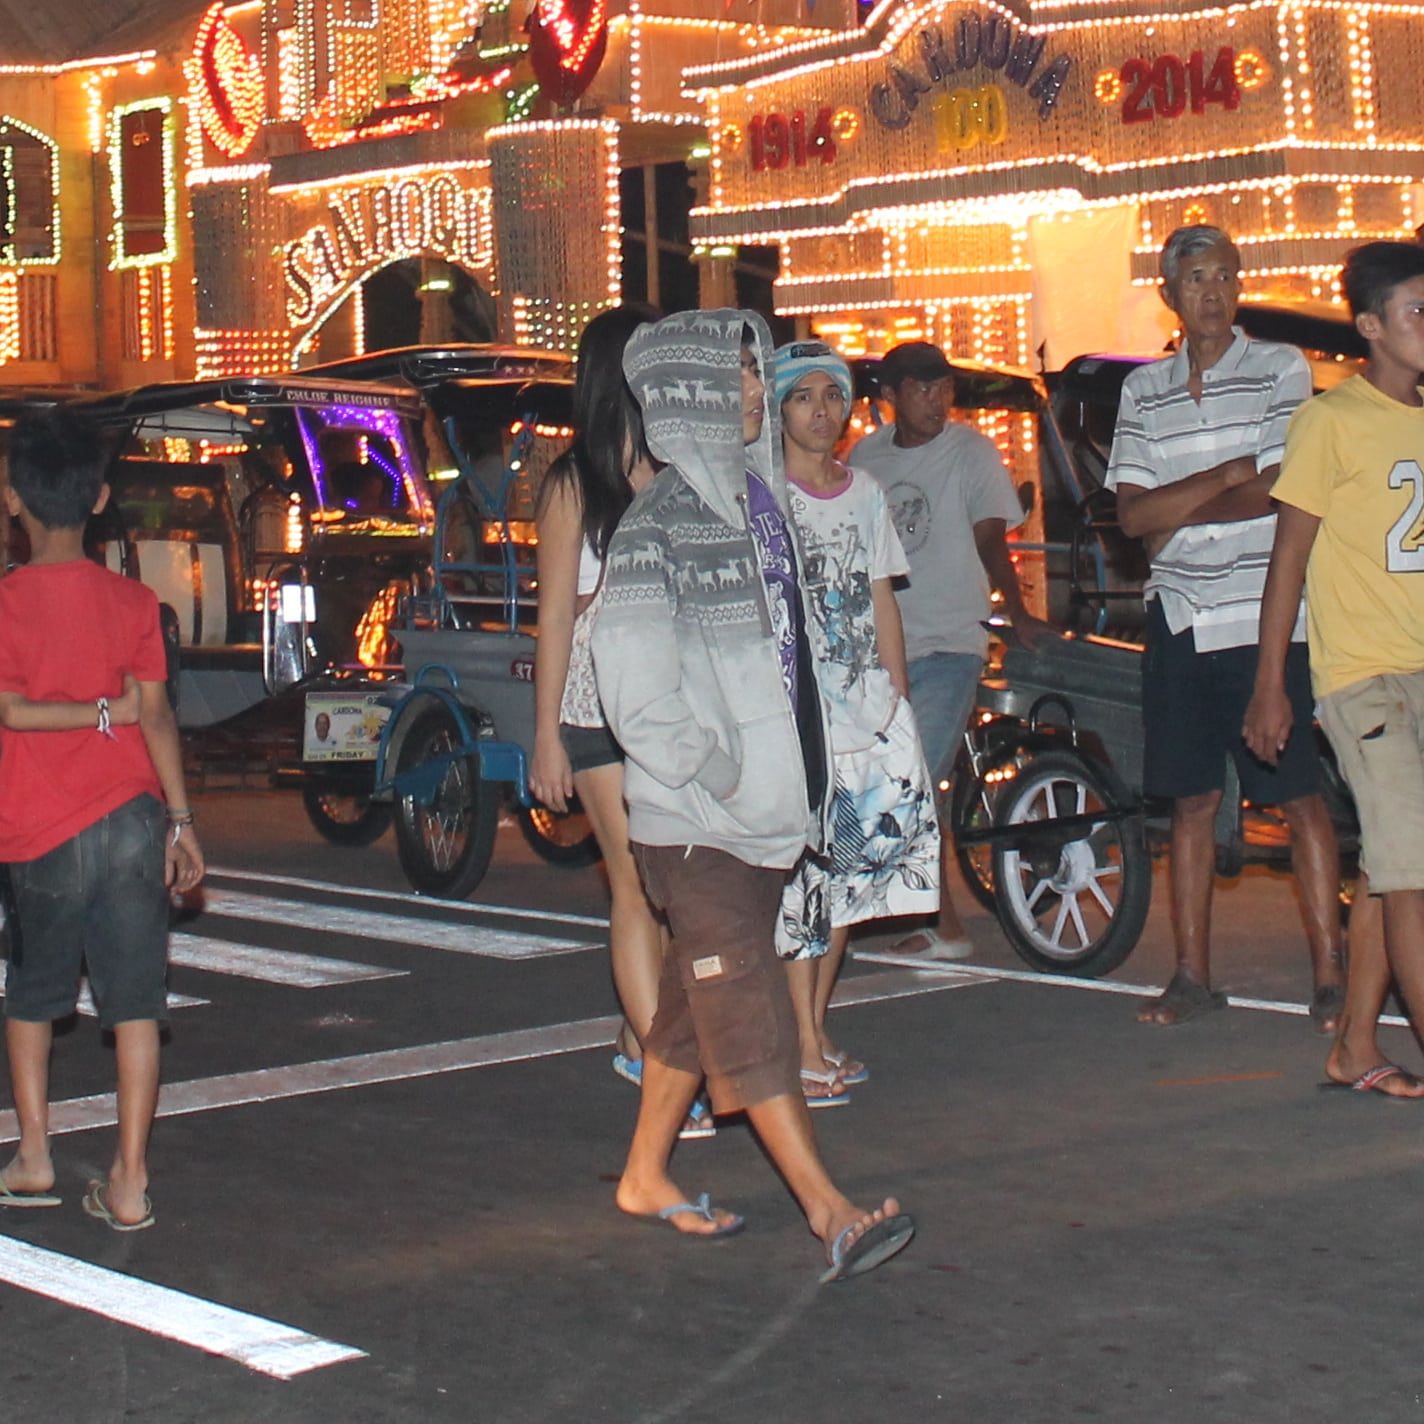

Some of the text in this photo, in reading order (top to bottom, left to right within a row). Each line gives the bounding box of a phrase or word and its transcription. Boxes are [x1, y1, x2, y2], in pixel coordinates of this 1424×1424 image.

[934, 84, 1008, 153] 100
[1119, 45, 1242, 125] 2014
[747, 106, 837, 172] 1914
[281, 185, 368, 328] SAN
[286, 389, 329, 403] CHLOE
